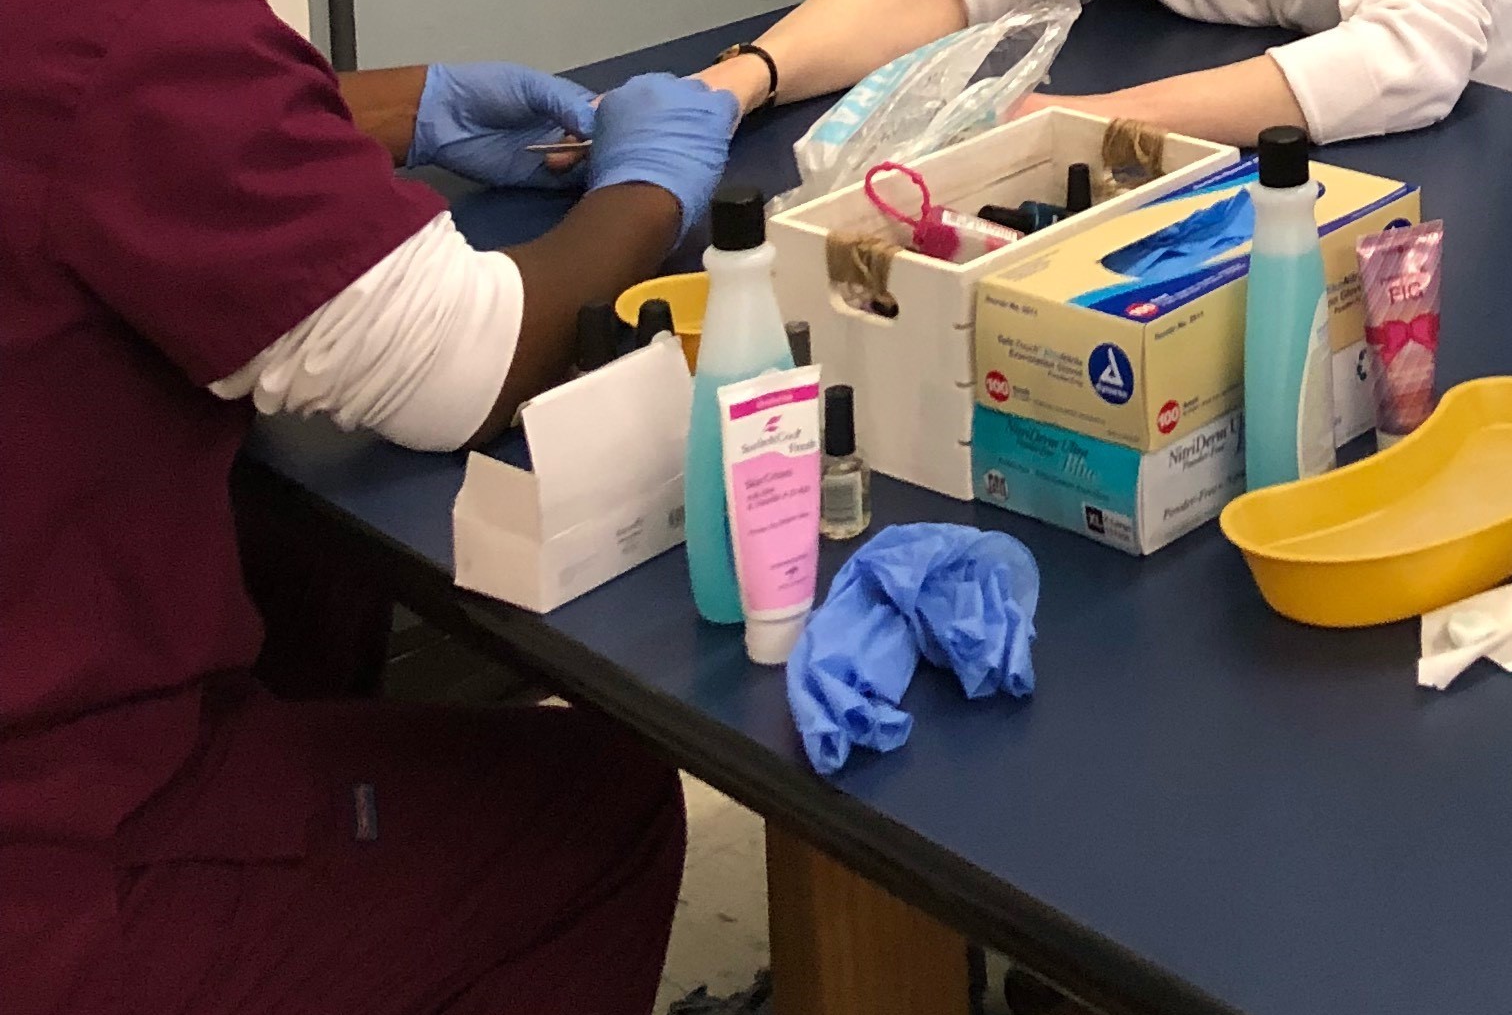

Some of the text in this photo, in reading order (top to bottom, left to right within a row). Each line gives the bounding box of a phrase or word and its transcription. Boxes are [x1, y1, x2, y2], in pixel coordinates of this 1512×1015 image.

[986, 377, 1010, 397] 100
[1157, 406, 1180, 429] 100
[1168, 428, 1227, 469] NitriDerm
